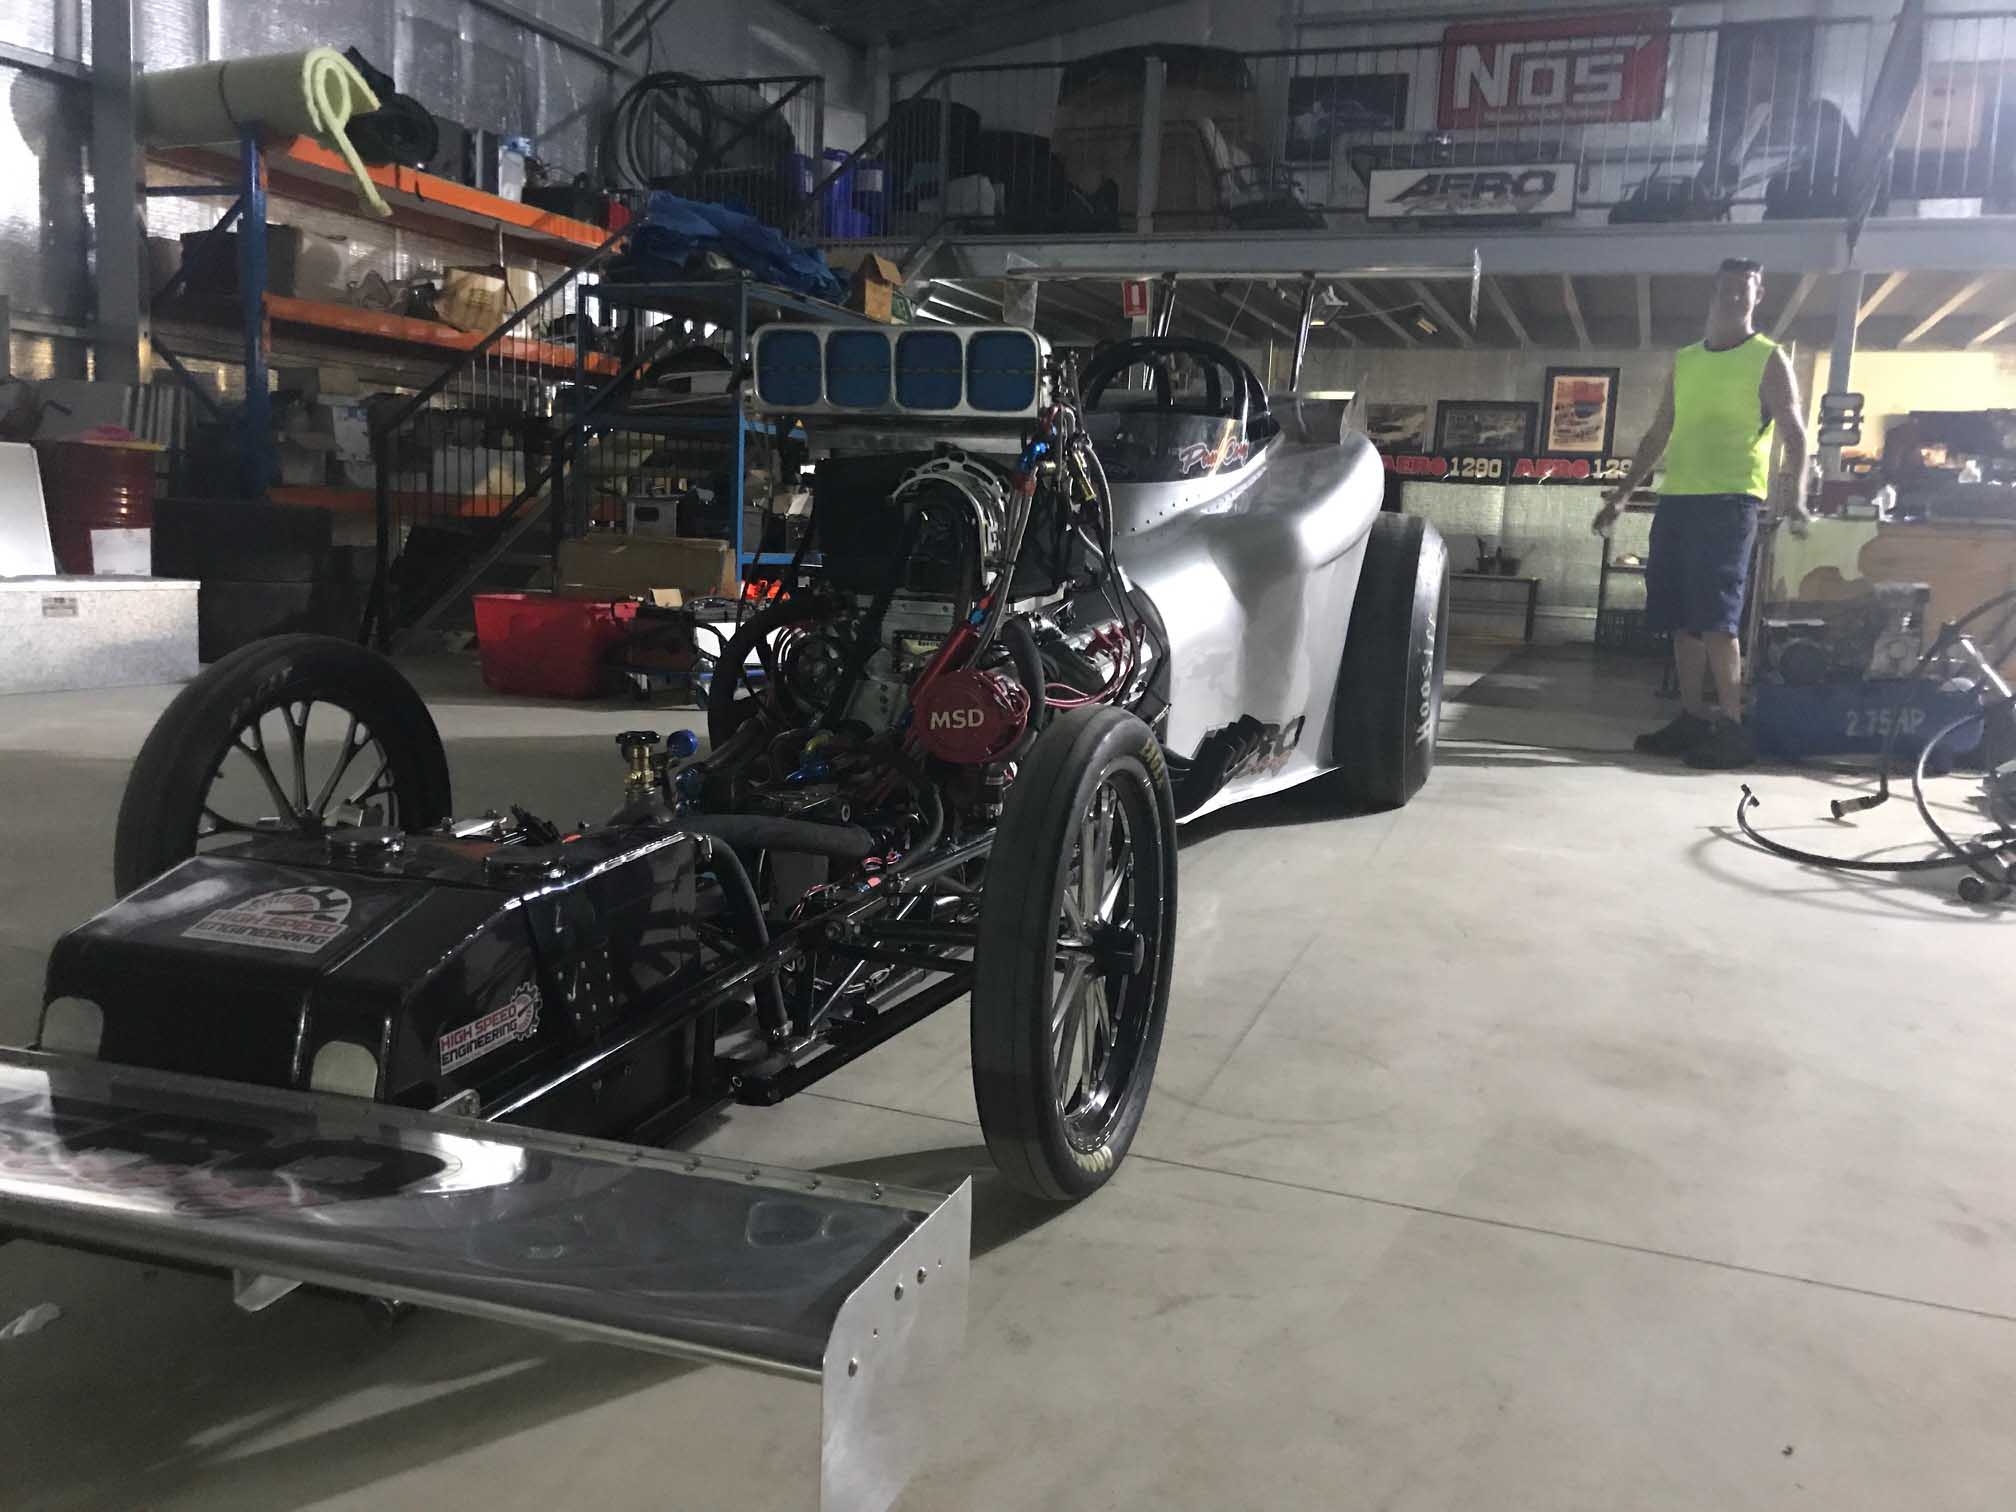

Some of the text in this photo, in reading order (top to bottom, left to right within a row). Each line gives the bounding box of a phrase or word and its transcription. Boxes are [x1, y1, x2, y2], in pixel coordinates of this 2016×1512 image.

[1453, 35, 1651, 109] NOS
[1592, 458, 1634, 479] 129
[930, 708, 985, 730] MSD
[440, 1004, 517, 1052] HIGH SPEED
[441, 1018, 518, 1066] ENGINEERING
